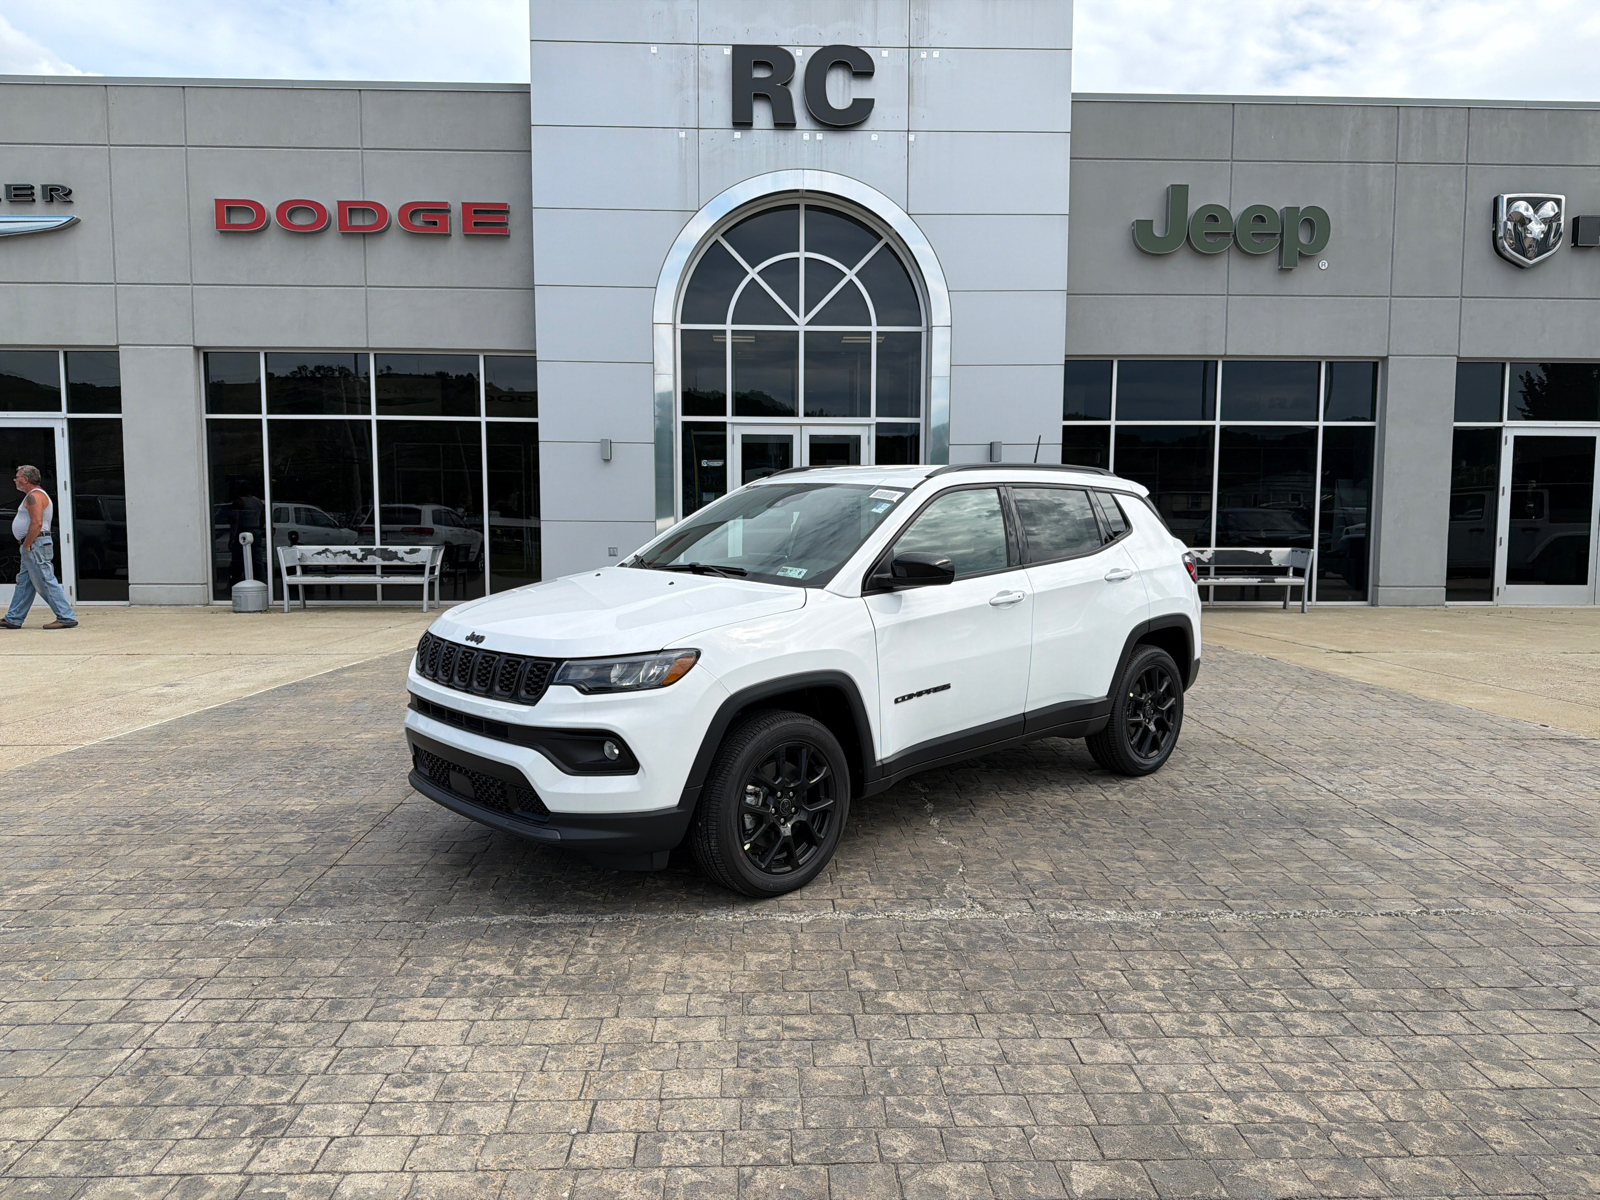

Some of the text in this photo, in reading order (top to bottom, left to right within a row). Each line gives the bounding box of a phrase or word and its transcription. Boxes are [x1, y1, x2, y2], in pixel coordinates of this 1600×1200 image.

[732, 44, 875, 128] RC
[0, 183, 74, 203] ER
[213, 198, 511, 237] DODGE
[1132, 184, 1331, 270] Jeep
[893, 682, 951, 704] COMPASS
